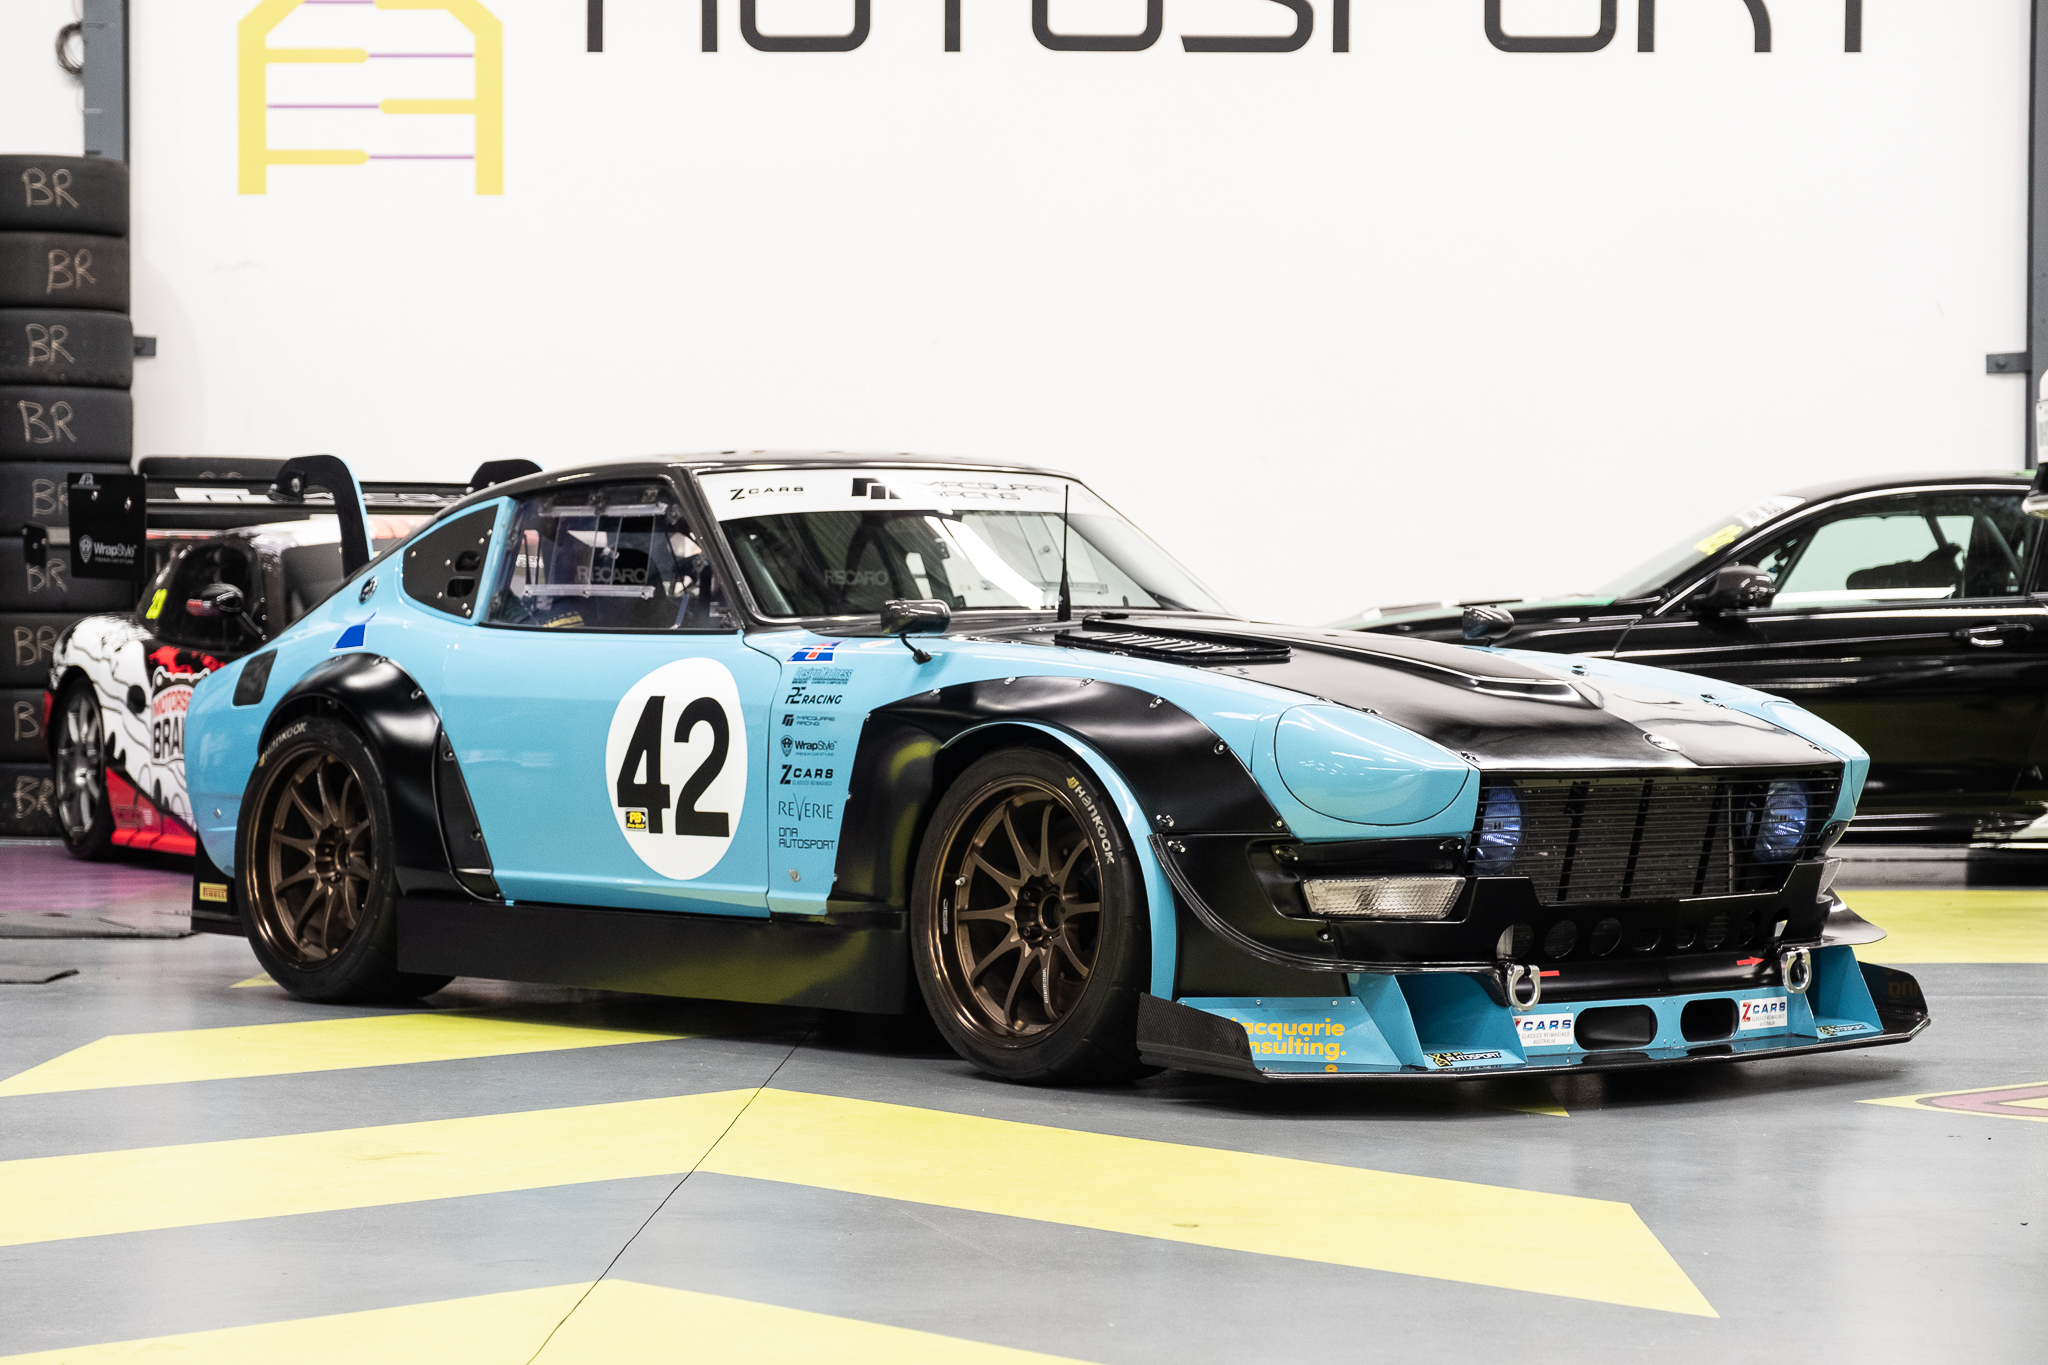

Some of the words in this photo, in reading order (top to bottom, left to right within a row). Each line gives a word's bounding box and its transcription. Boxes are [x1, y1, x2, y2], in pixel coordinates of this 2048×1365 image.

[21, 167, 79, 208] BR
[46, 248, 97, 295] BR
[25, 323, 76, 367] BR
[17, 400, 78, 444] BR
[824, 569, 889, 587] RECARO
[617, 695, 730, 837] 42
[13, 775, 55, 818] BR
[778, 793, 834, 821] REVERIE
[778, 838, 835, 850] AUTOSPORT
[1231, 1017, 1345, 1041] acquarie
[1522, 1019, 1572, 1031] CARS
